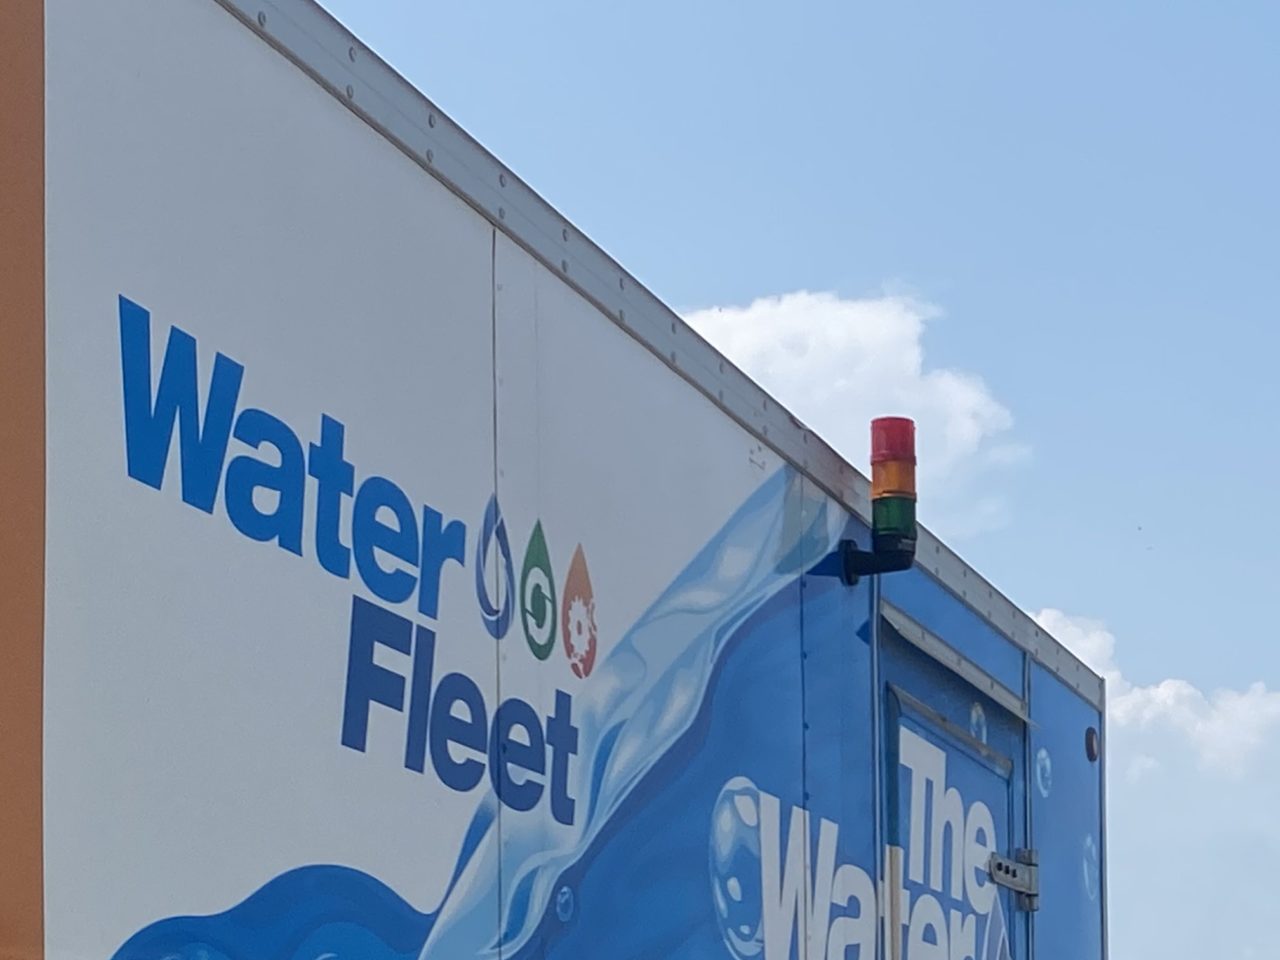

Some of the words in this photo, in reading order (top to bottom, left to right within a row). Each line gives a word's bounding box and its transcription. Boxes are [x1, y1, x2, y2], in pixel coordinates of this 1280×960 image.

[118, 293, 467, 620] Water
[341, 594, 579, 826] Fleet
[900, 724, 996, 915] The
